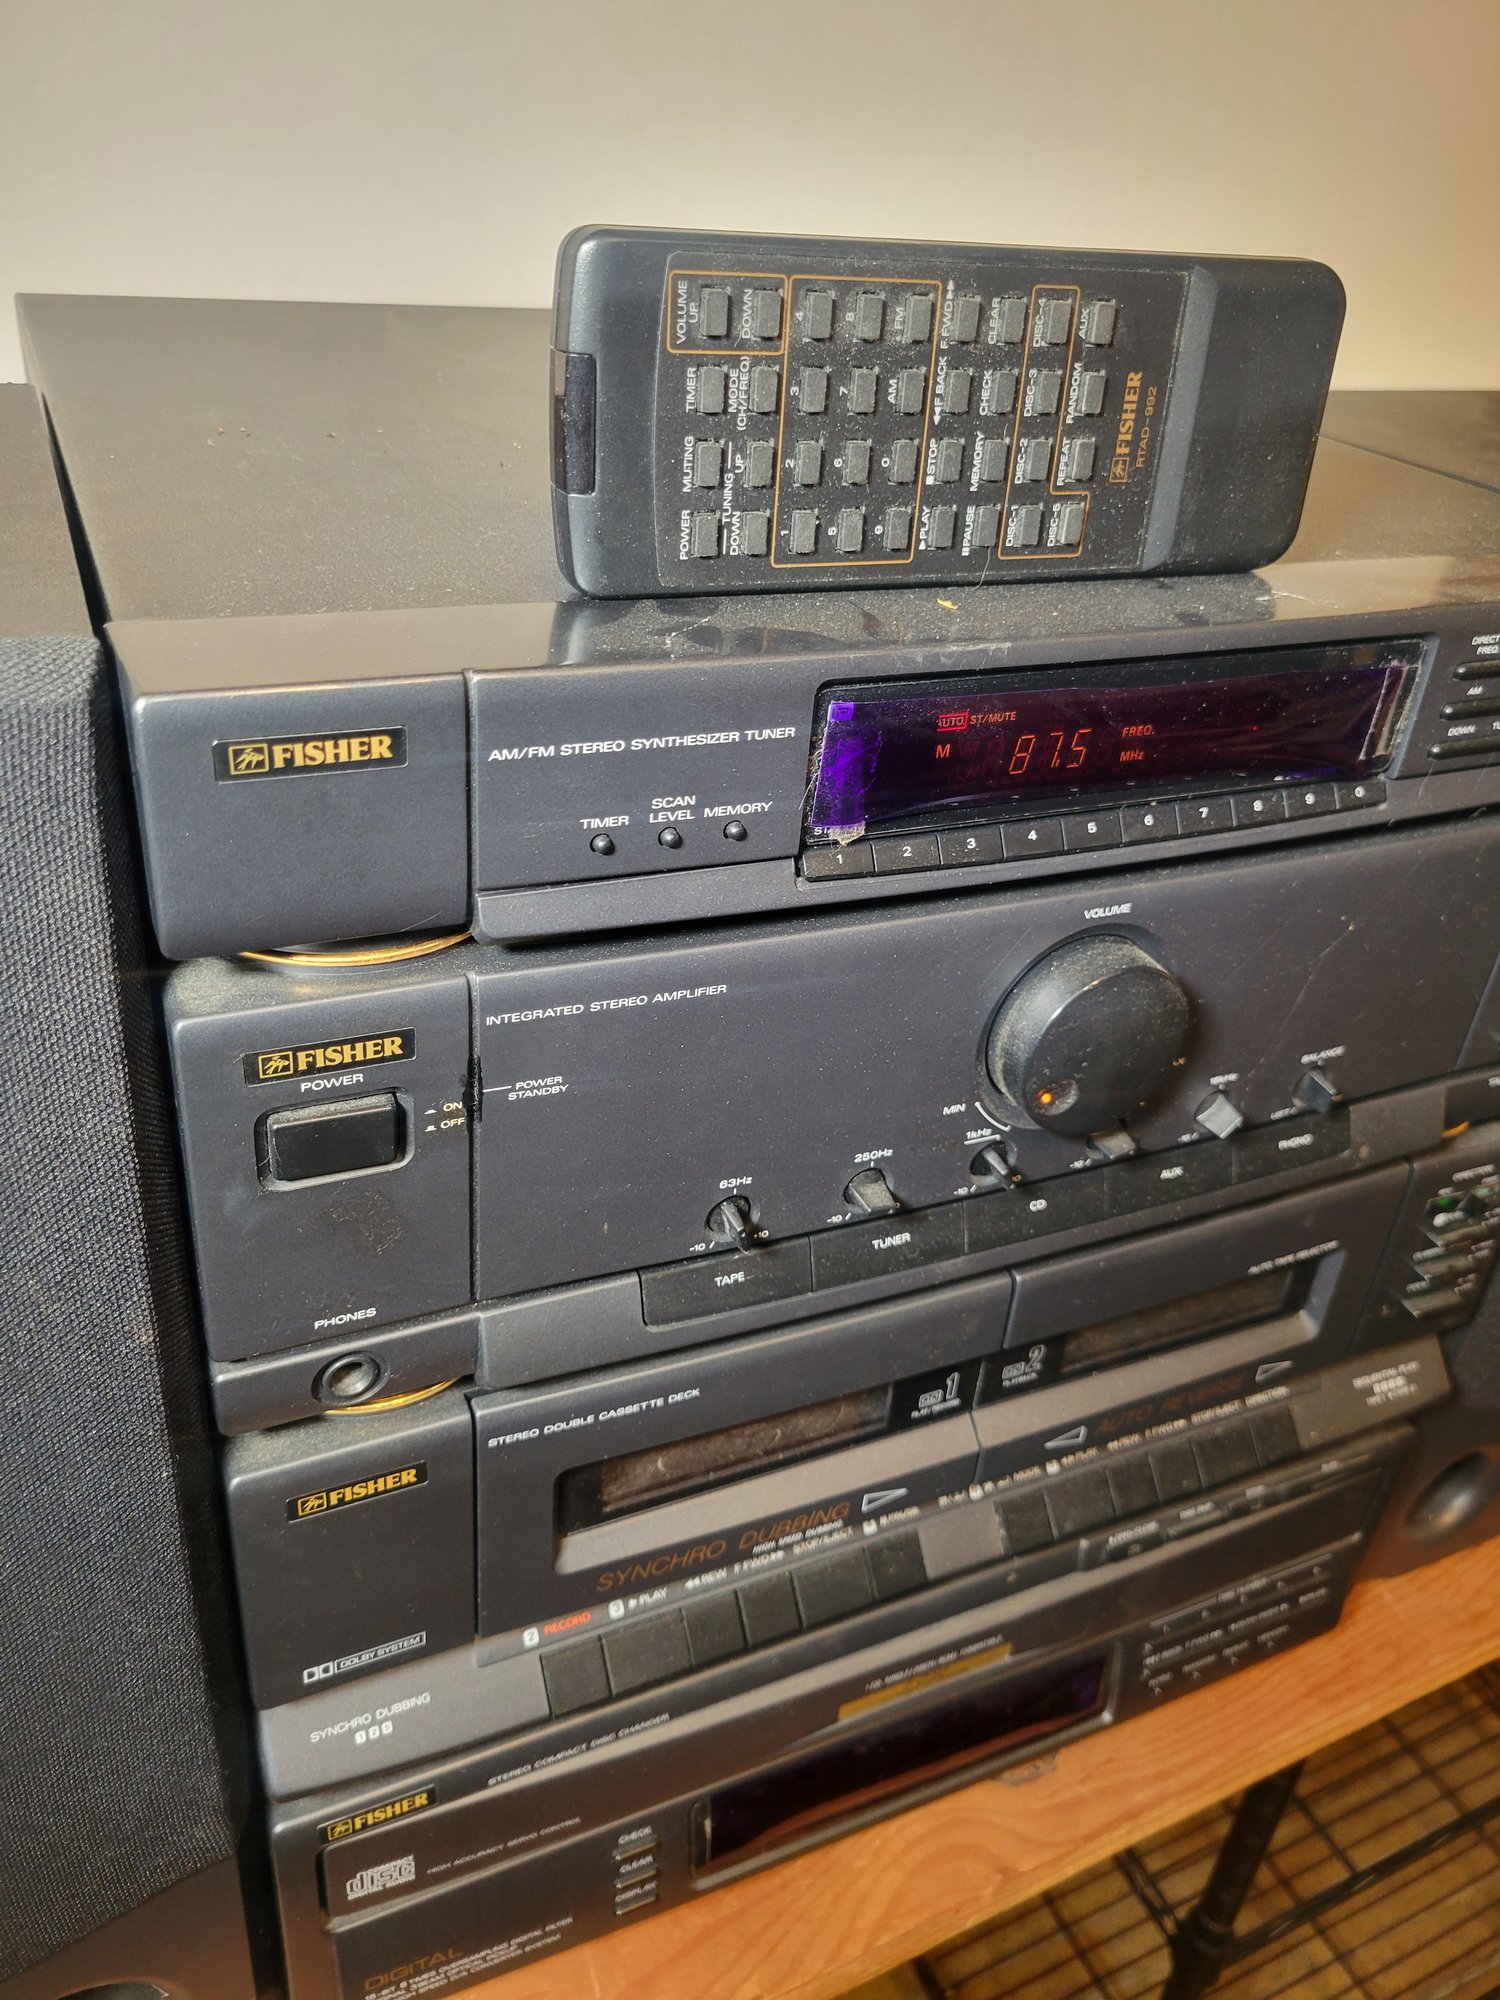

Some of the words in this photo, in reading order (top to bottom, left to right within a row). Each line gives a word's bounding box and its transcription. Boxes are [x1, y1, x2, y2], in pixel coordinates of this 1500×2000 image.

[676, 280, 688, 345] VOLUME
[689, 302, 698, 323] UP
[742, 289, 753, 339] DOWN
[795, 312, 803, 322] 4
[846, 312, 855, 322] 8
[894, 307, 905, 330] FM
[988, 298, 1000, 345] CLEAR
[1033, 300, 1045, 348] DISC-4
[1079, 308, 1090, 340] AUX
[685, 367, 698, 413] TIMER
[728, 368, 739, 413] MODE
[736, 356, 750, 432] (CH/FREQ)
[790, 386, 800, 396] 3
[839, 386, 848, 397] 7
[887, 378, 899, 404] AM
[979, 369, 992, 416] CHECK
[1024, 369, 1038, 417] DISC-3
[1066, 362, 1083, 424] RANDOM
[1116, 371, 1142, 458] FISHER
[1136, 386, 1158, 468] RTAD-992
[683, 436, 694, 493] MUTING
[735, 454, 745, 474] UP
[785, 458, 795, 468] 2
[927, 438, 938, 475] STOP
[970, 430, 985, 492] MEMORY
[1014, 438, 1028, 485] DISC-2
[1056, 437, 1072, 486] REPEAT
[722, 472, 734, 526] TUNING
[828, 526, 837, 537] 5
[920, 506, 930, 540] PLAY
[962, 505, 975, 548] PAUSE
[1006, 504, 1020, 548] DISC-1
[1048, 502, 1061, 548] DISC-5
[680, 509, 691, 561] POWER
[730, 511, 741, 556] DOWN
[1466, 686, 1484, 696] AM
[970, 711, 1017, 724] ST/MUTE
[1122, 724, 1156, 738] FREQ.
[1448, 724, 1477, 737] DOWN
[272, 735, 393, 769] FISHER
[488, 746, 555, 762] AM/FM
[560, 740, 626, 756] STEREO
[630, 731, 740, 751] SYNTHESIZER
[744, 727, 796, 741] TUNER
[936, 744, 951, 759] M
[1120, 749, 1144, 762] MHz
[651, 795, 696, 810] SCAN
[1252, 800, 1264, 812] 8
[1304, 792, 1316, 805] 9
[649, 810, 696, 823] LEVEL
[704, 801, 773, 818] MEMORY
[1198, 806, 1210, 818] 7
[580, 815, 630, 830] TIMER
[1087, 822, 1098, 834] 5
[1143, 814, 1154, 826] 6
[966, 838, 977, 850] 3
[1027, 830, 1038, 842] 4
[836, 854, 844, 864] 1
[902, 846, 912, 857] 2
[1084, 902, 1132, 920] VOLUME
[486, 1004, 584, 1026] INTEGRATED
[590, 996, 648, 1012] STEREO
[652, 984, 728, 1004] AMPLIFIER
[296, 1036, 404, 1071] FISHER
[301, 1074, 364, 1093] POWER
[508, 1084, 569, 1101] STANDBY
[515, 1076, 563, 1091] POWER
[443, 1101, 463, 1112] ON
[942, 1102, 966, 1116] MIN
[440, 1117, 466, 1128] OFF
[966, 1127, 992, 1140] 1kHz
[854, 1148, 894, 1164] 250Hz
[719, 1175, 752, 1190] 63Hz
[1160, 1166, 1184, 1180] AUX
[953, 1186, 969, 1196] -10
[1029, 1198, 1048, 1212] CD
[826, 1214, 842, 1224] -10
[754, 1230, 769, 1238] +10
[872, 1232, 912, 1250] TUNER
[689, 1242, 706, 1252] -10
[714, 1272, 746, 1288] TAPE
[314, 1307, 376, 1330] PHONES
[945, 1372, 960, 1400] 1
[488, 1428, 540, 1448] STEREO
[544, 1414, 595, 1435] DOUBLE
[598, 1397, 664, 1421] CASSETTE
[668, 1387, 701, 1405] DECK
[329, 1468, 418, 1506] FISHER
[596, 1540, 727, 1592] SYNCHRO
[738, 1502, 850, 1550] DUBBING
[638, 1587, 668, 1607] PLAY
[543, 1610, 592, 1636] RECORD
[340, 1652, 376, 1669] DOLBY
[376, 1636, 421, 1658] SYSTEM
[310, 1713, 372, 1743] SYNCHRO
[375, 1692, 431, 1720] DUBBING
[354, 1792, 429, 1832] FISHER
[364, 1947, 464, 1992] DIGITAL
